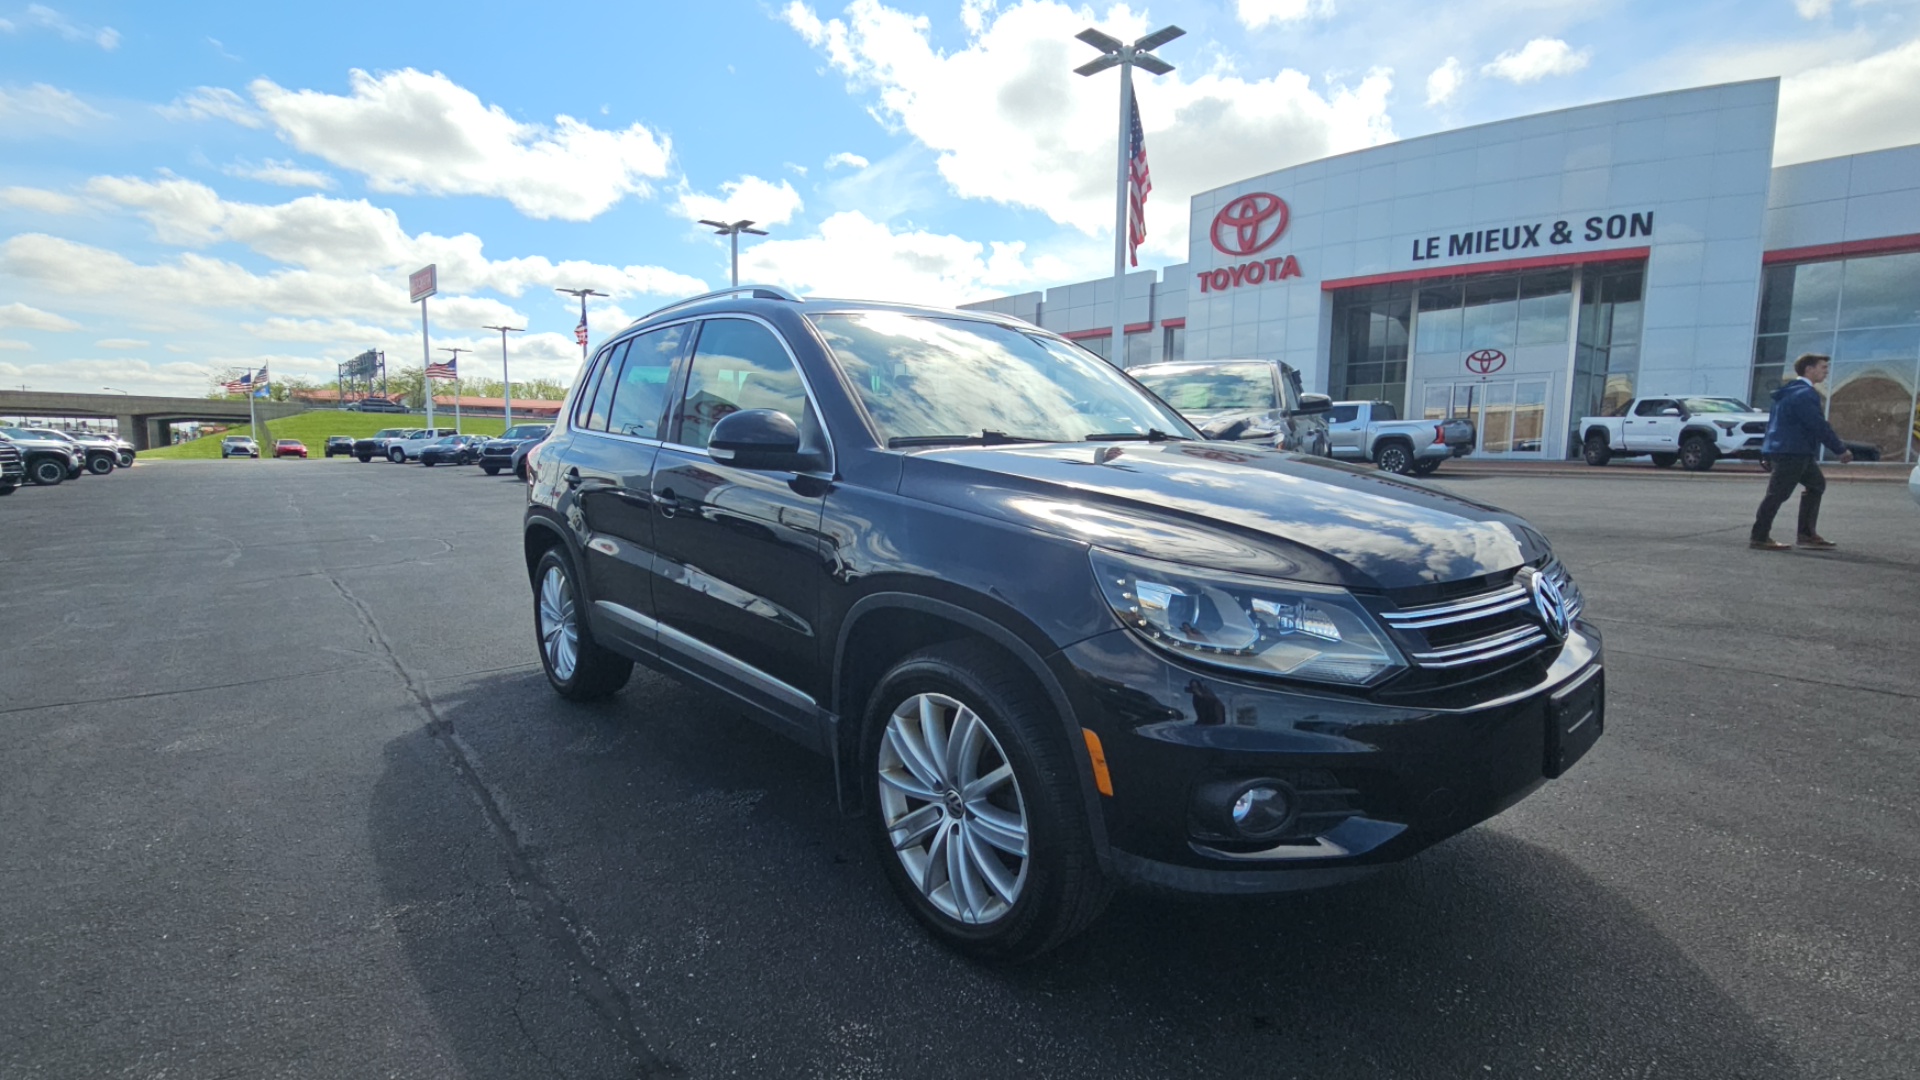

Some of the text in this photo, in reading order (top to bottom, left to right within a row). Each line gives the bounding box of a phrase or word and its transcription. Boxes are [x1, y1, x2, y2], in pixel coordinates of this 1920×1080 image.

[1413, 211, 1653, 260] LE MIEUX & SON
[1198, 256, 1301, 293] TOYOTA
